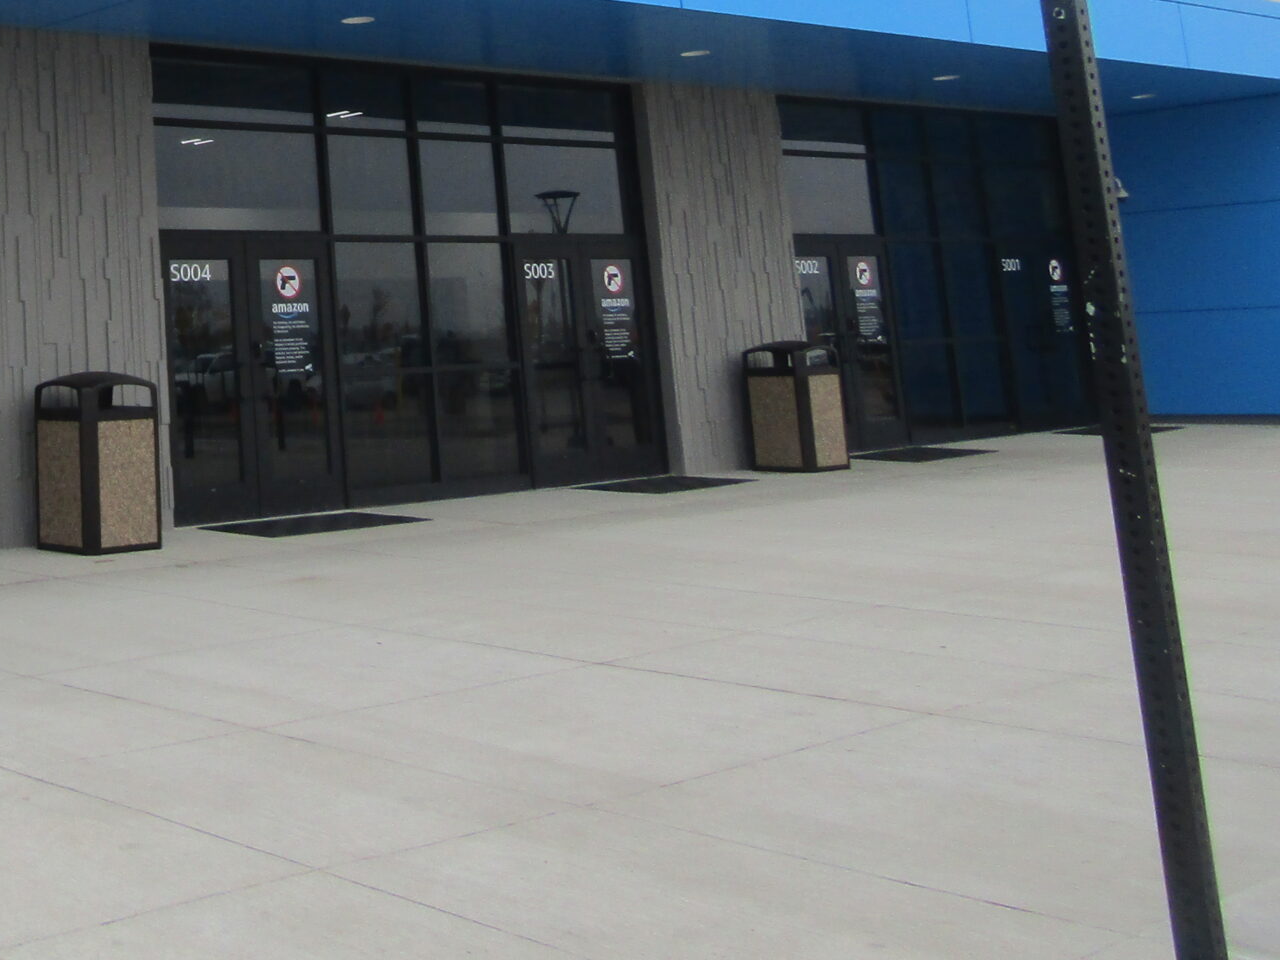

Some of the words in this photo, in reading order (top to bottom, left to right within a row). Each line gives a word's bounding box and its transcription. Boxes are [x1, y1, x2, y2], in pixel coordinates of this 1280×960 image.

[170, 263, 211, 281] S004
[524, 263, 555, 279] S003
[795, 260, 819, 274] S002
[272, 302, 309, 313] amazon
